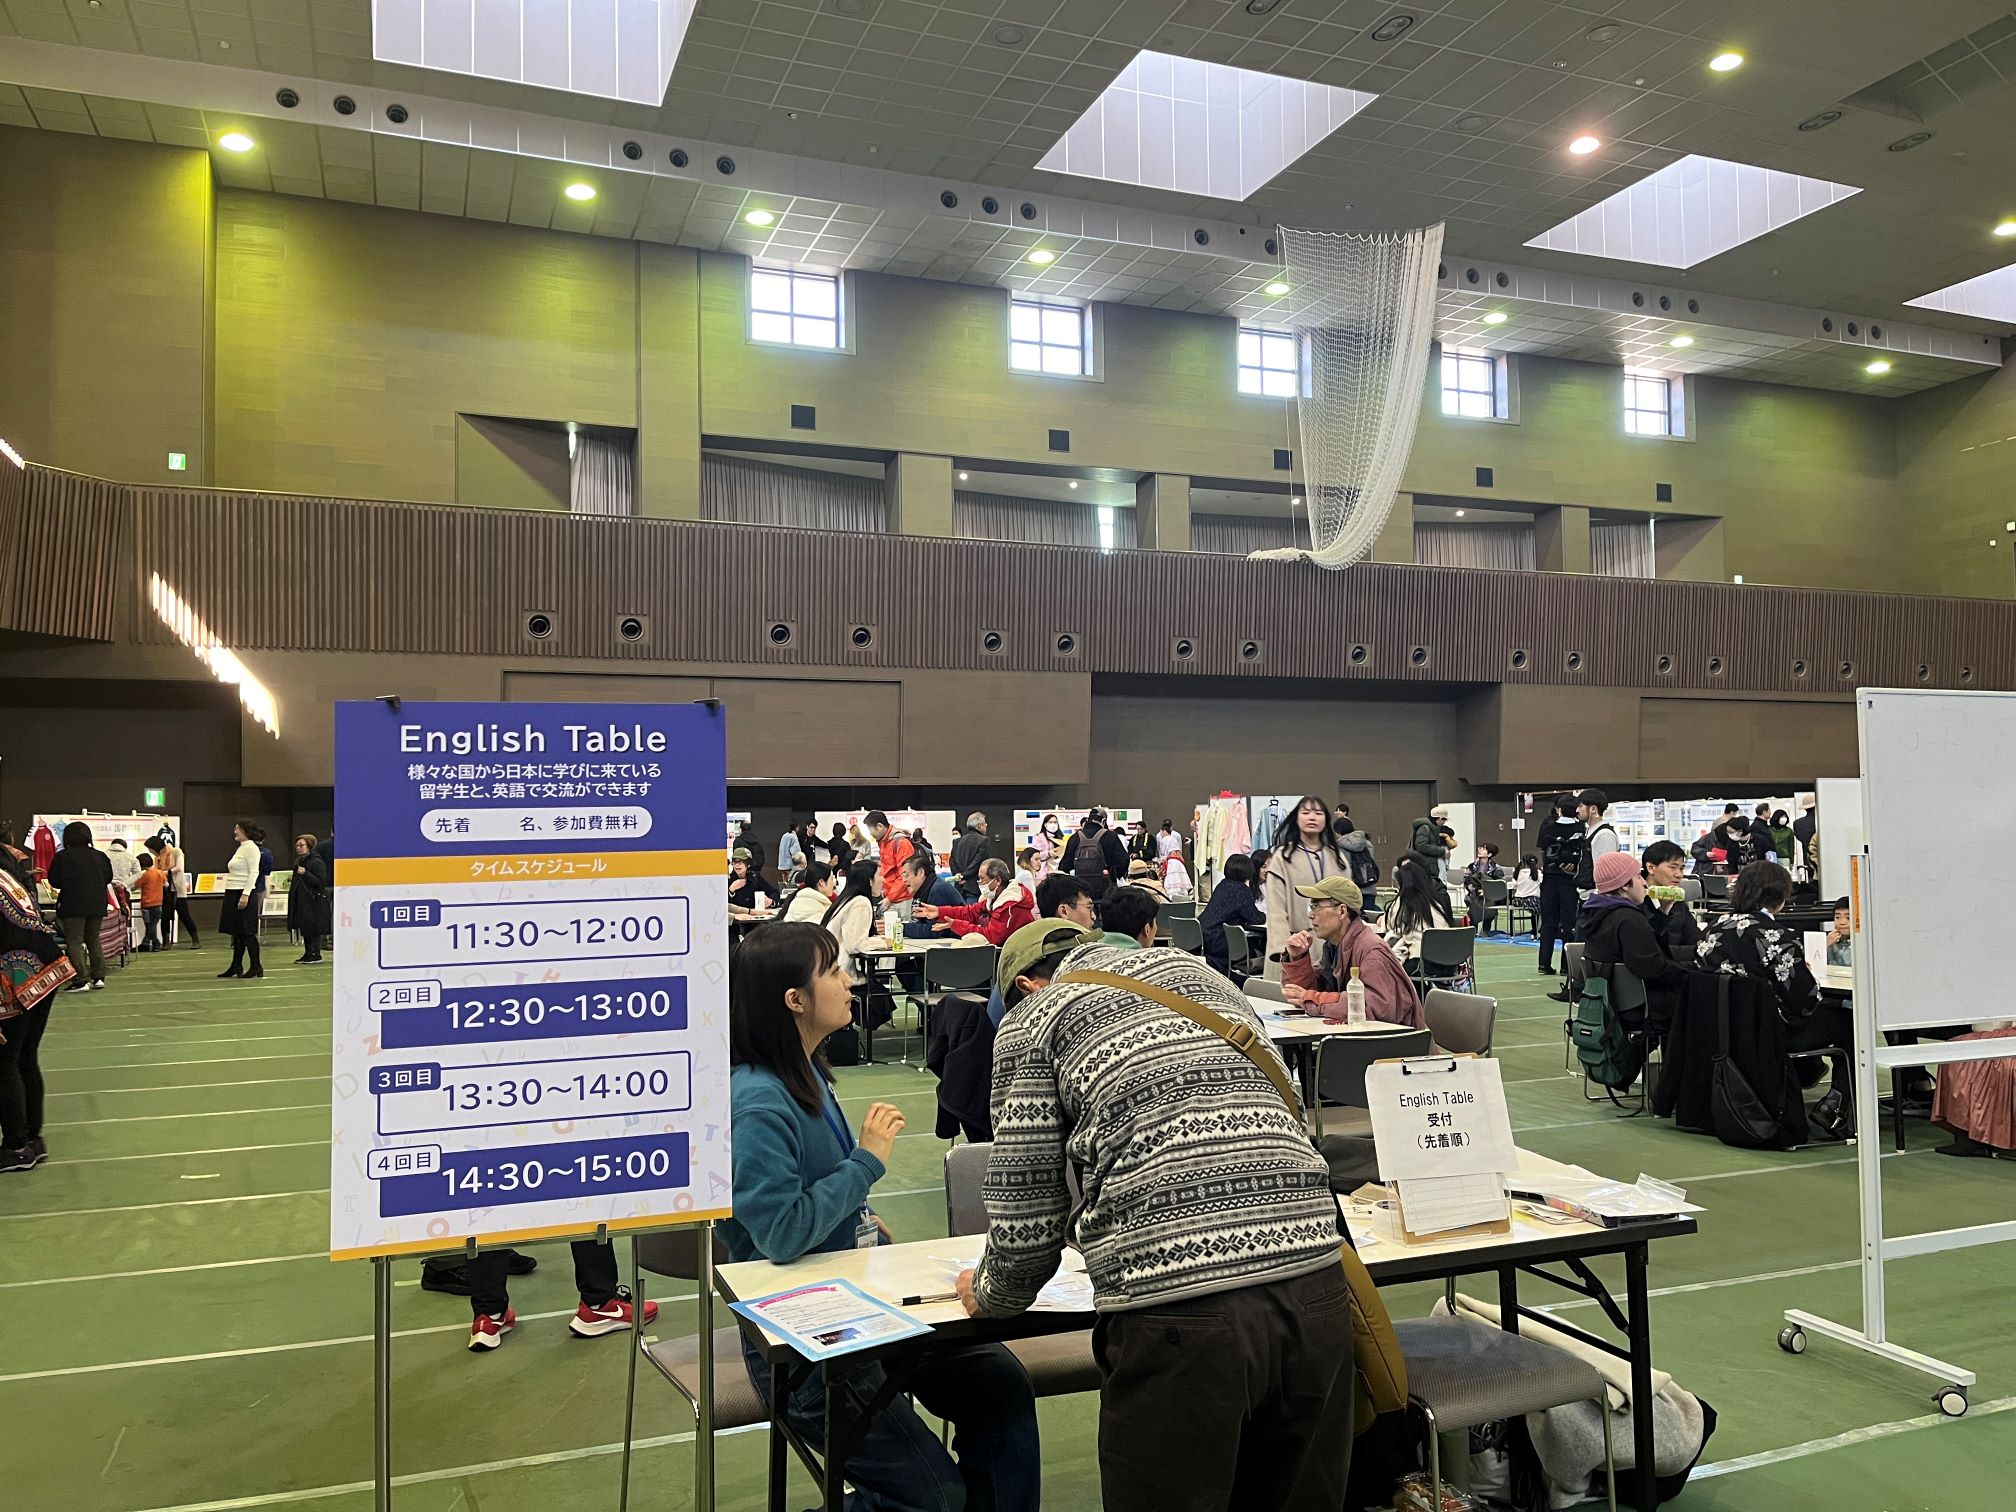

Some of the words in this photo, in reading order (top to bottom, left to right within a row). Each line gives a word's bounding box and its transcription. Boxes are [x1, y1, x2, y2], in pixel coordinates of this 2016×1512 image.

[400, 724, 546, 755] English
[563, 724, 668, 753] Table
[407, 763, 661, 780] 様々な国から日本に学びに来ている
[419, 782, 652, 800] 留学生と、英語で交流ができます
[435, 817, 471, 833] 先着
[519, 815, 639, 832] 名、参加費無料
[470, 858, 608, 876] タイムスケジュール
[380, 905, 431, 923] 1回目
[378, 987, 432, 1004] 2回目
[378, 1069, 432, 1087] 3回目
[1399, 1093, 1440, 1108] English
[1442, 1091, 1474, 1105] Table
[1427, 1112, 1452, 1128] 受付
[377, 1152, 432, 1171] 4回目
